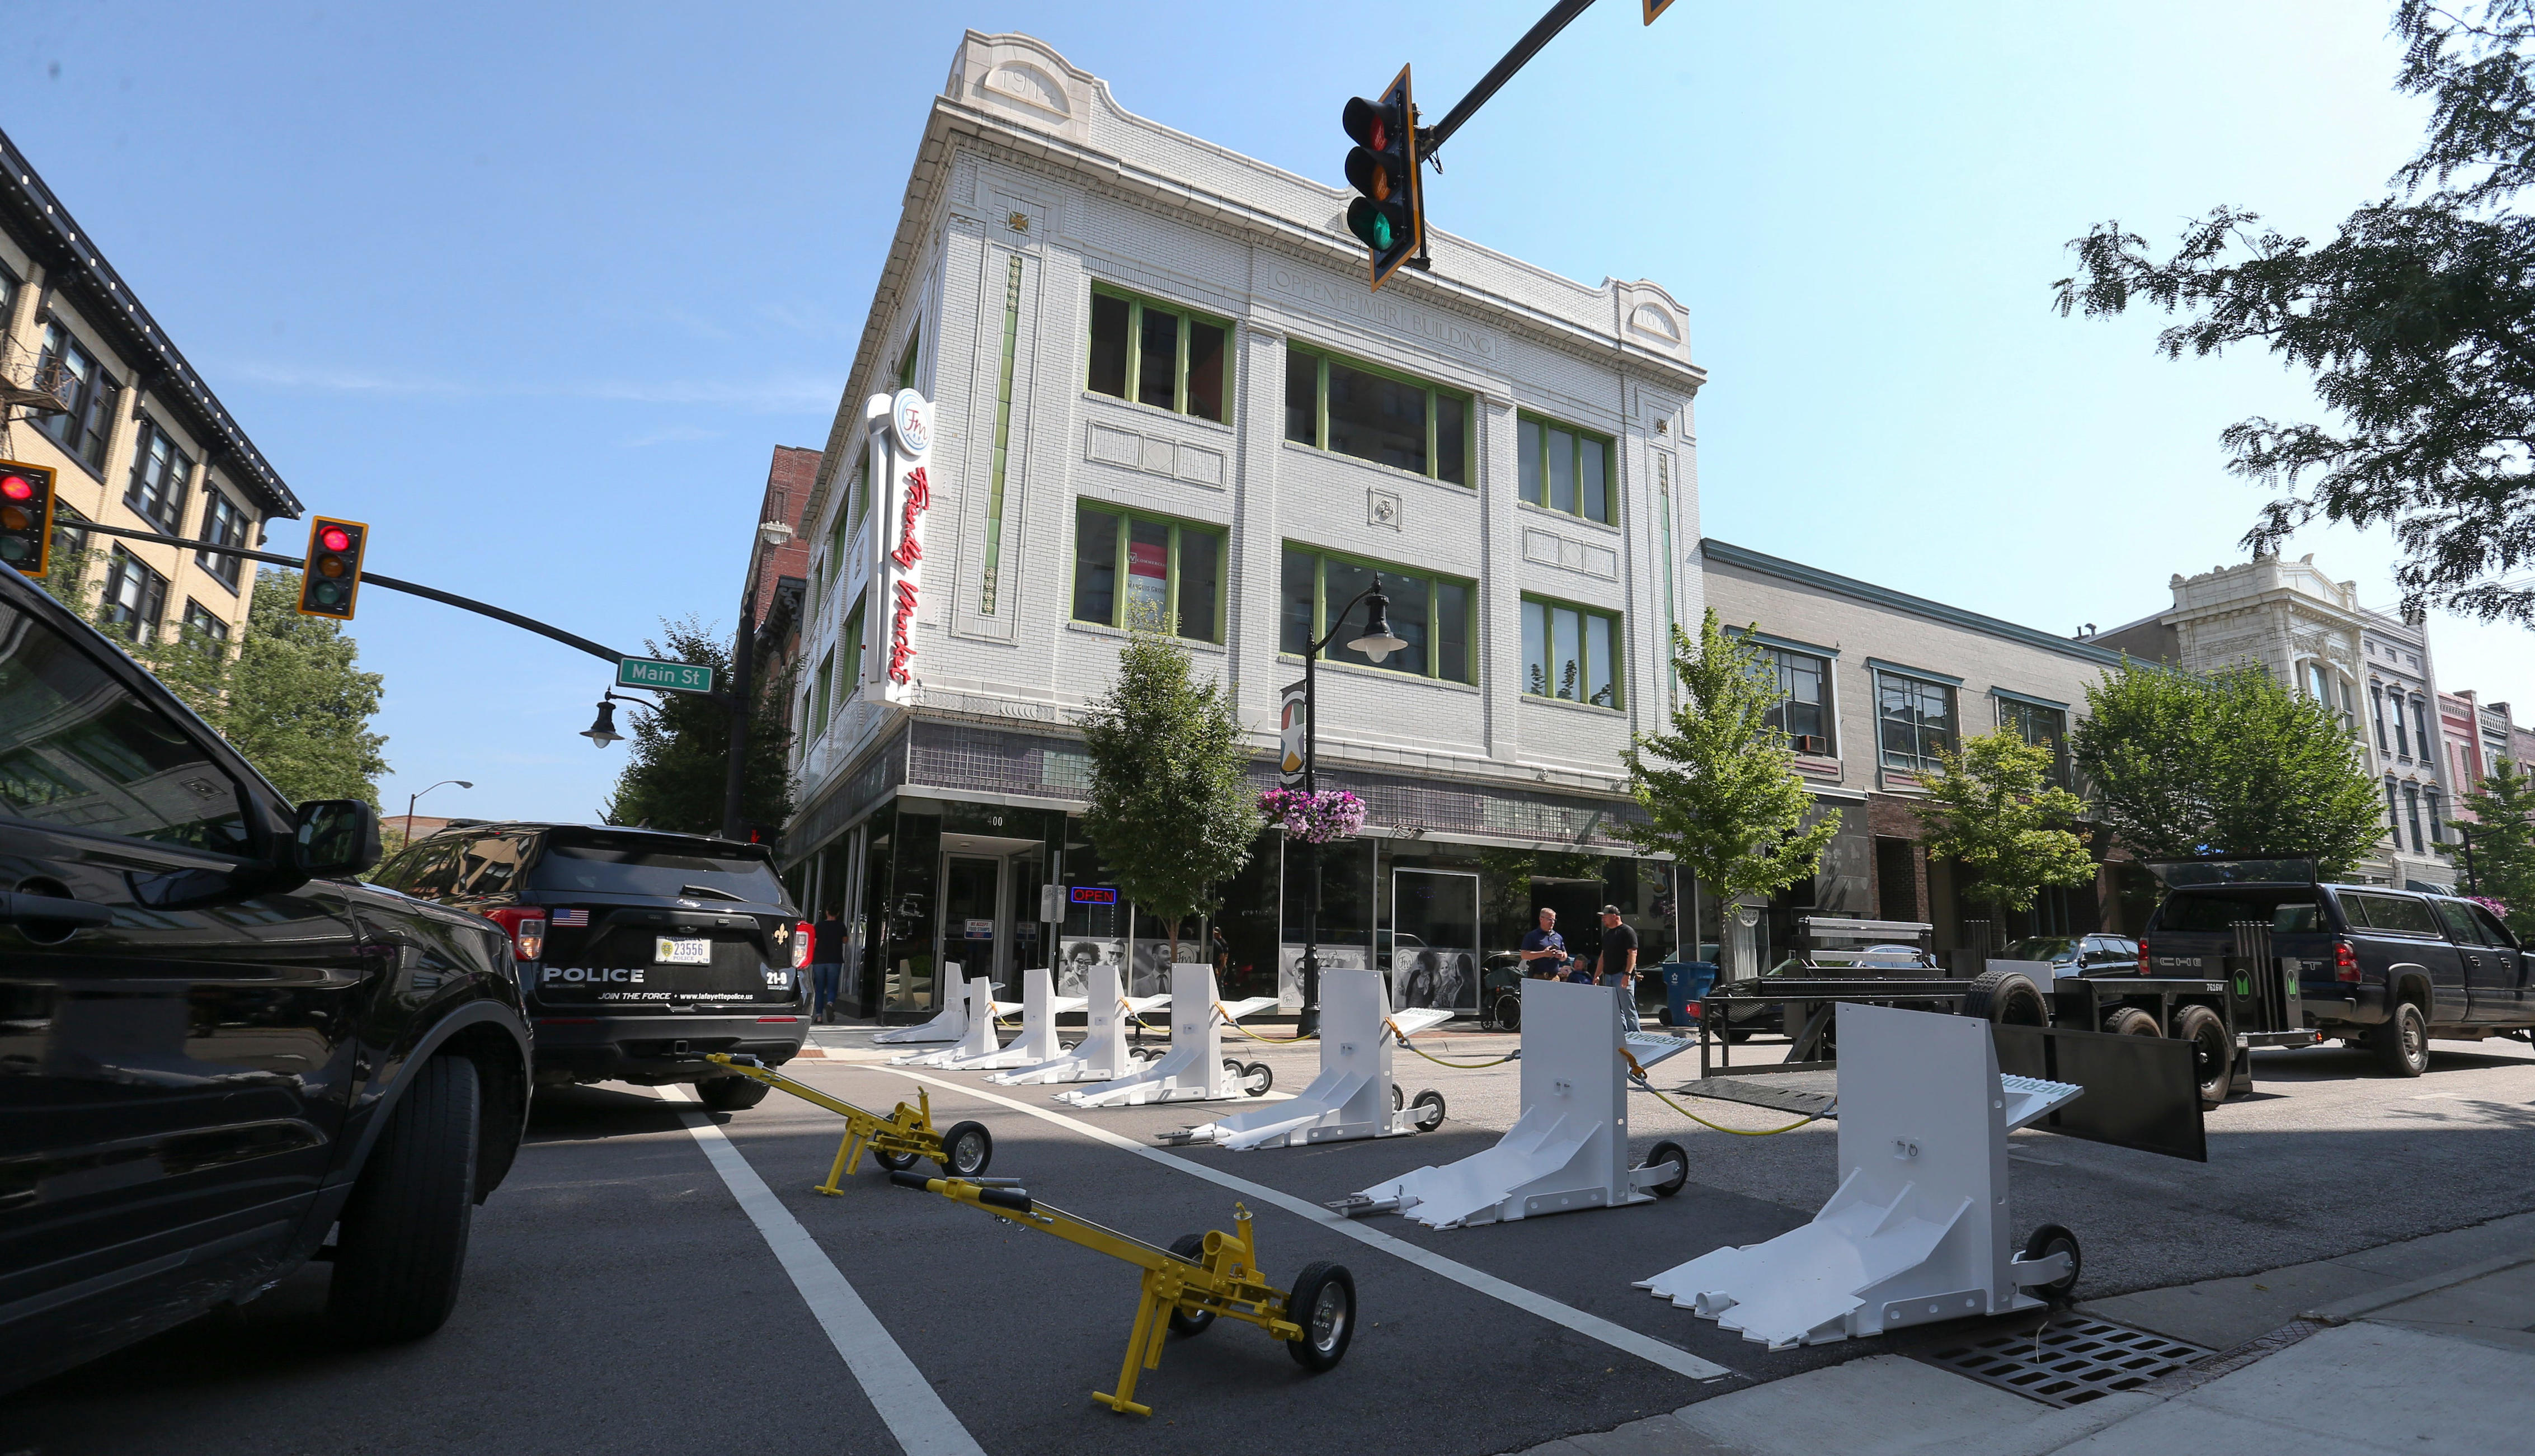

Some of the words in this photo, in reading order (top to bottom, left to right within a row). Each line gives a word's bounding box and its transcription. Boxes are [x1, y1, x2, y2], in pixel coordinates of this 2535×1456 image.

[1274, 270, 1400, 325] OPPENHEIMER
[1413, 316, 1492, 354] BUILDING
[891, 467, 930, 570] Friendly
[888, 579, 919, 685] Market
[632, 663, 675, 682] Main
[681, 670, 700, 685] St
[1074, 889, 1113, 902] OPEN
[674, 943, 703, 956] 23556
[543, 968, 645, 983] POLICE
[766, 972, 787, 984] 21-9
[2207, 983, 2223, 992] 7616W
[680, 993, 753, 1001] www.lafayettepolice.us
